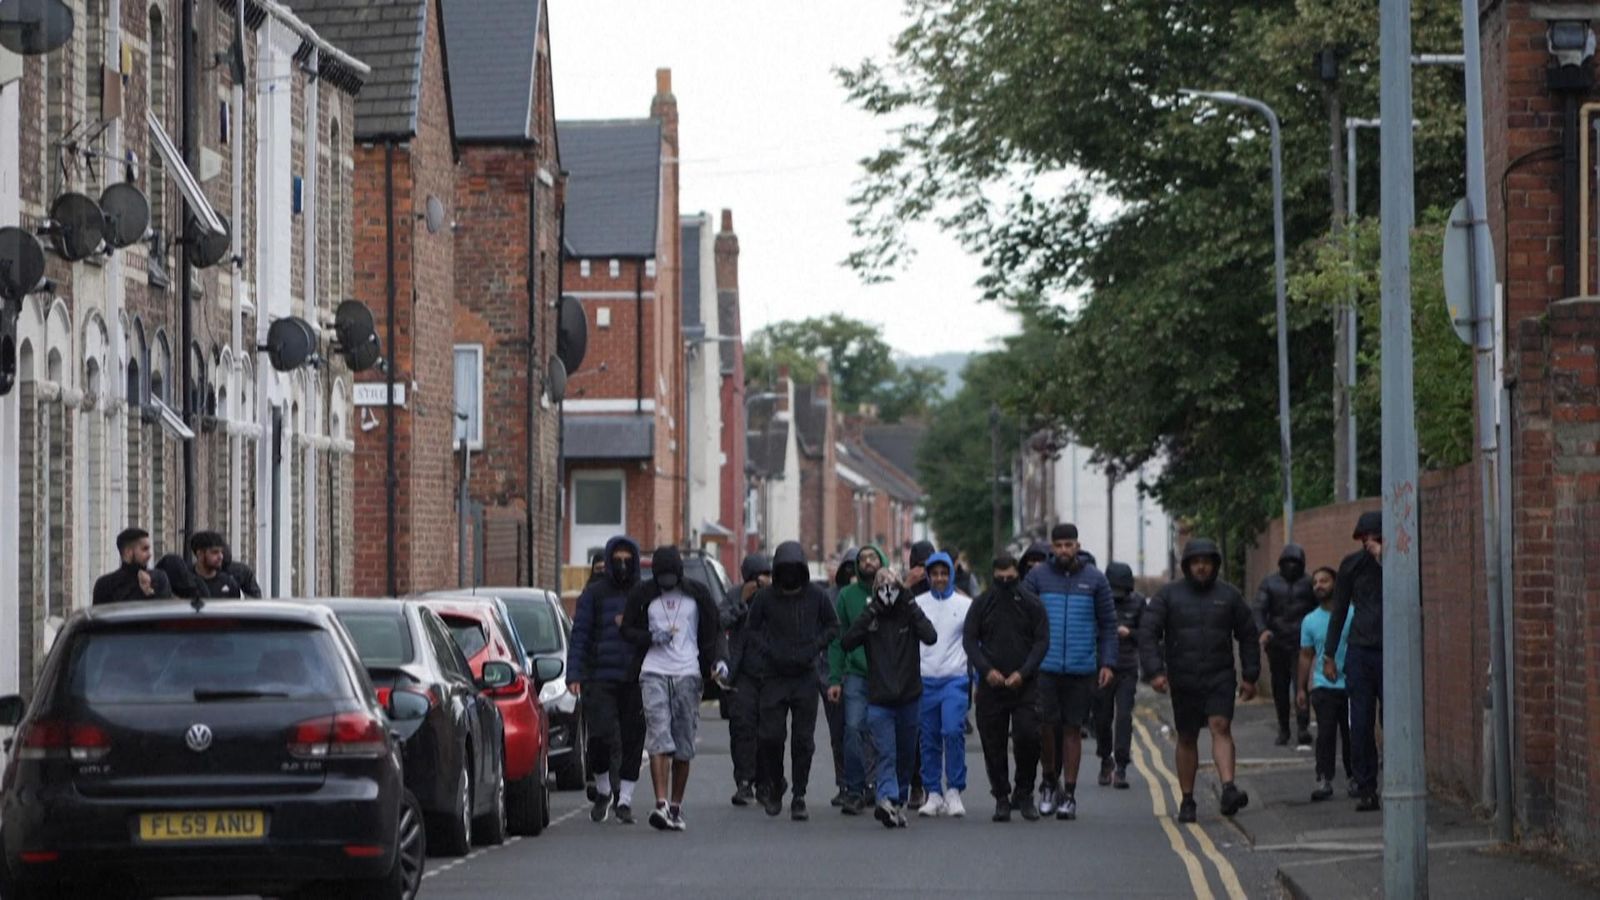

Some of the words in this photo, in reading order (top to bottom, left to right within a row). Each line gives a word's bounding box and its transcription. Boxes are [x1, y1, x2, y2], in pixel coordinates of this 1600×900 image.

[358, 386, 400, 400] STRET
[151, 814, 207, 835] FL59
[215, 812, 256, 833] ANU
